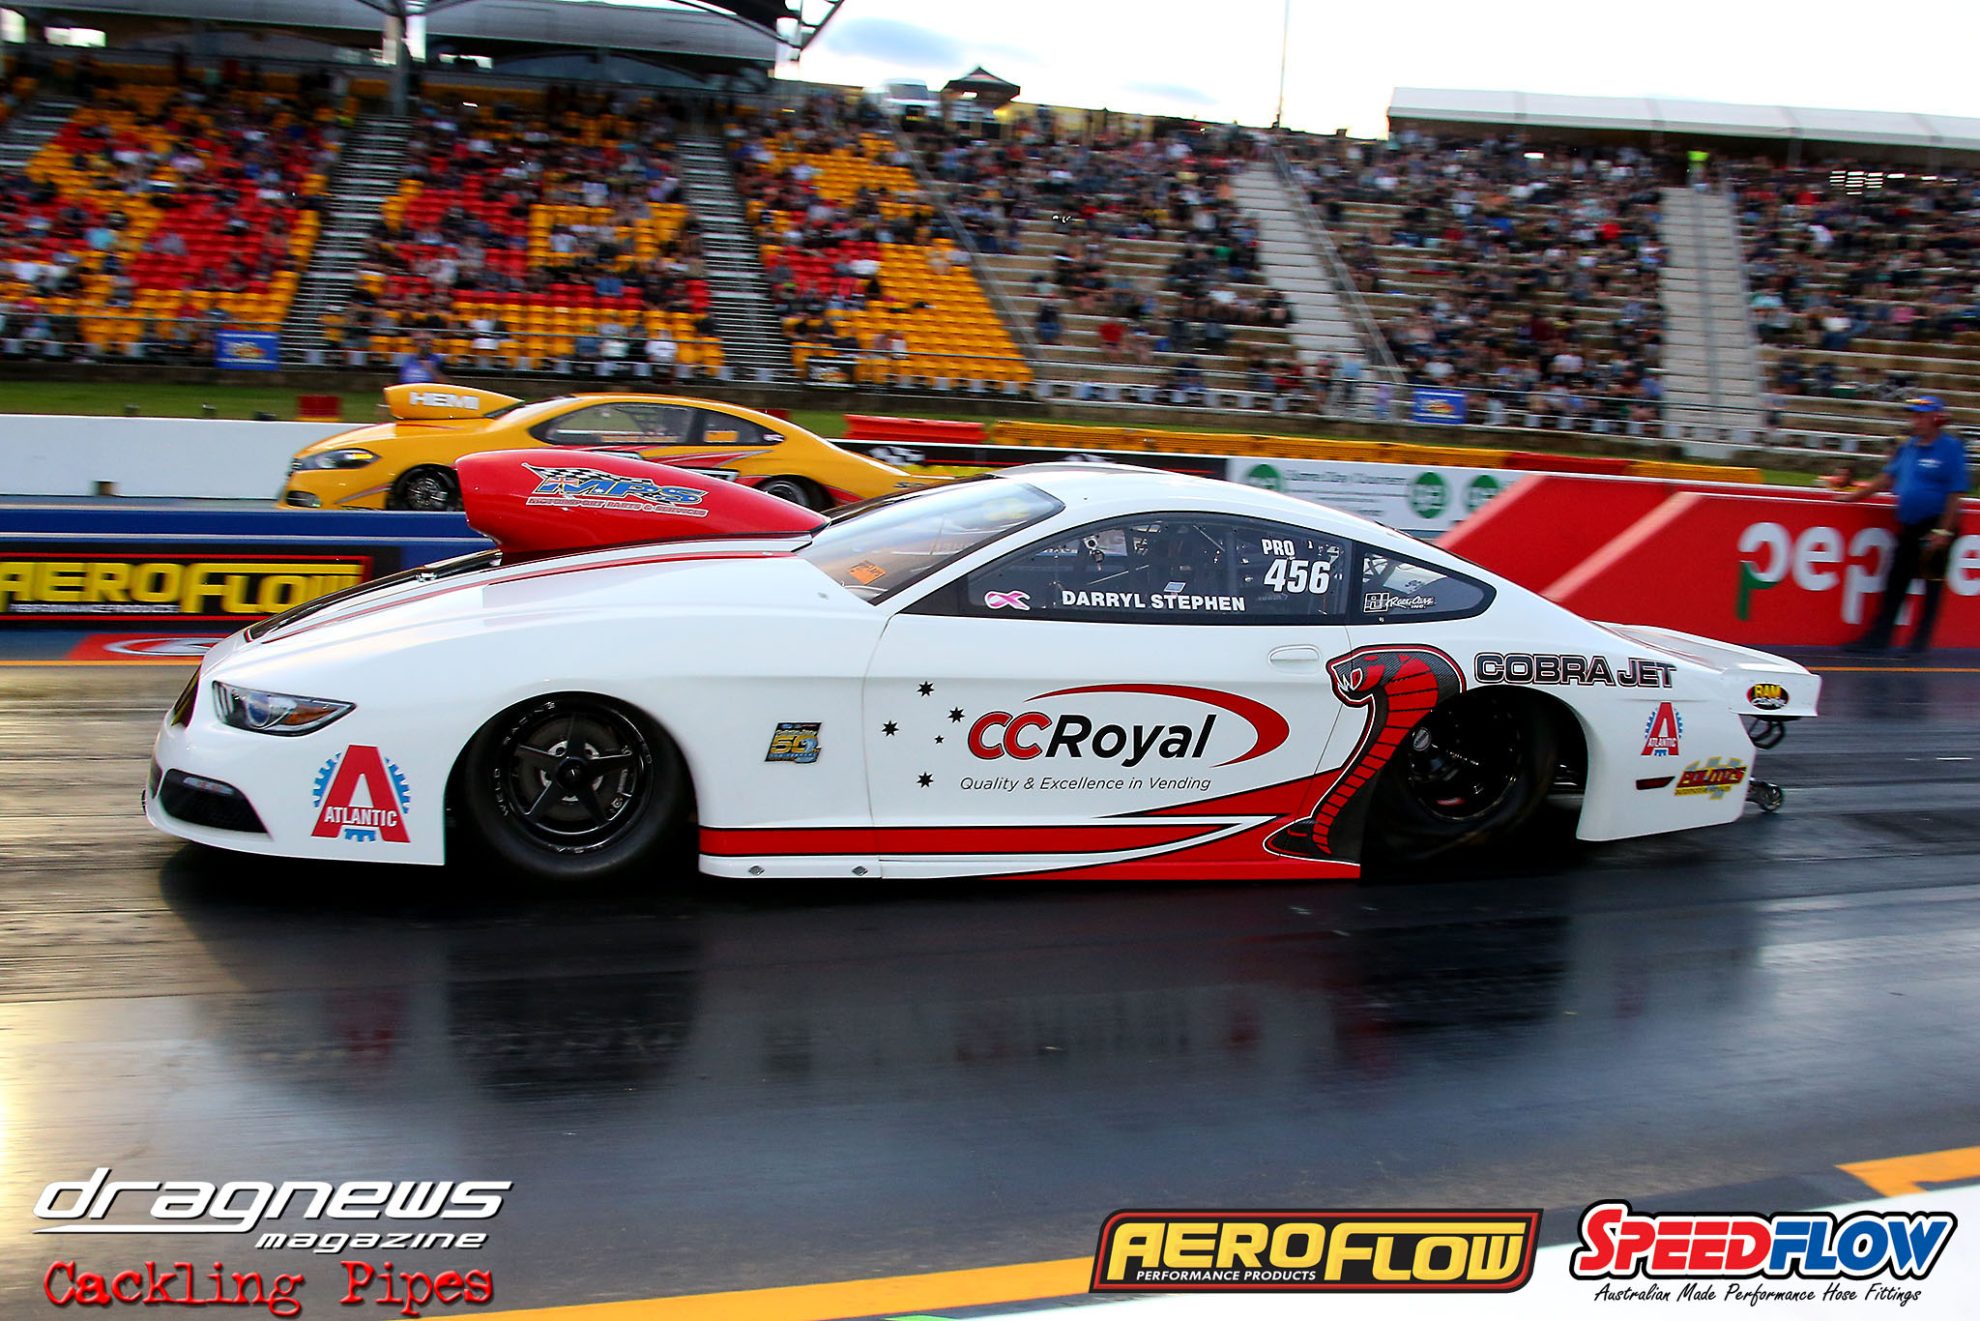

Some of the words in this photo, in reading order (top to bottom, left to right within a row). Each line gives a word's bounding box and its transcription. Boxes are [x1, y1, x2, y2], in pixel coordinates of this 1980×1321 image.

[408, 391, 480, 411] HEMI
[533, 475, 710, 505] MPS
[1261, 538, 1296, 557] PRO
[1263, 559, 1331, 595] 456
[1736, 521, 1980, 624] pepe
[1061, 590, 1146, 608] DARRYL
[1150, 594, 1246, 612] STEPHEN
[1474, 652, 1616, 687] COBRA
[1616, 657, 1678, 688] JET
[1754, 684, 1782, 698] RAM
[967, 710, 1218, 768] CCRoyal
[1647, 737, 1678, 748] ATLANTIC
[960, 776, 1019, 792] Quality
[1023, 777, 1035, 790] &
[1040, 776, 1124, 790] Excellence
[1128, 777, 1143, 790] in
[1148, 776, 1212, 792] Vending
[324, 806, 398, 828] ATLANTIC
